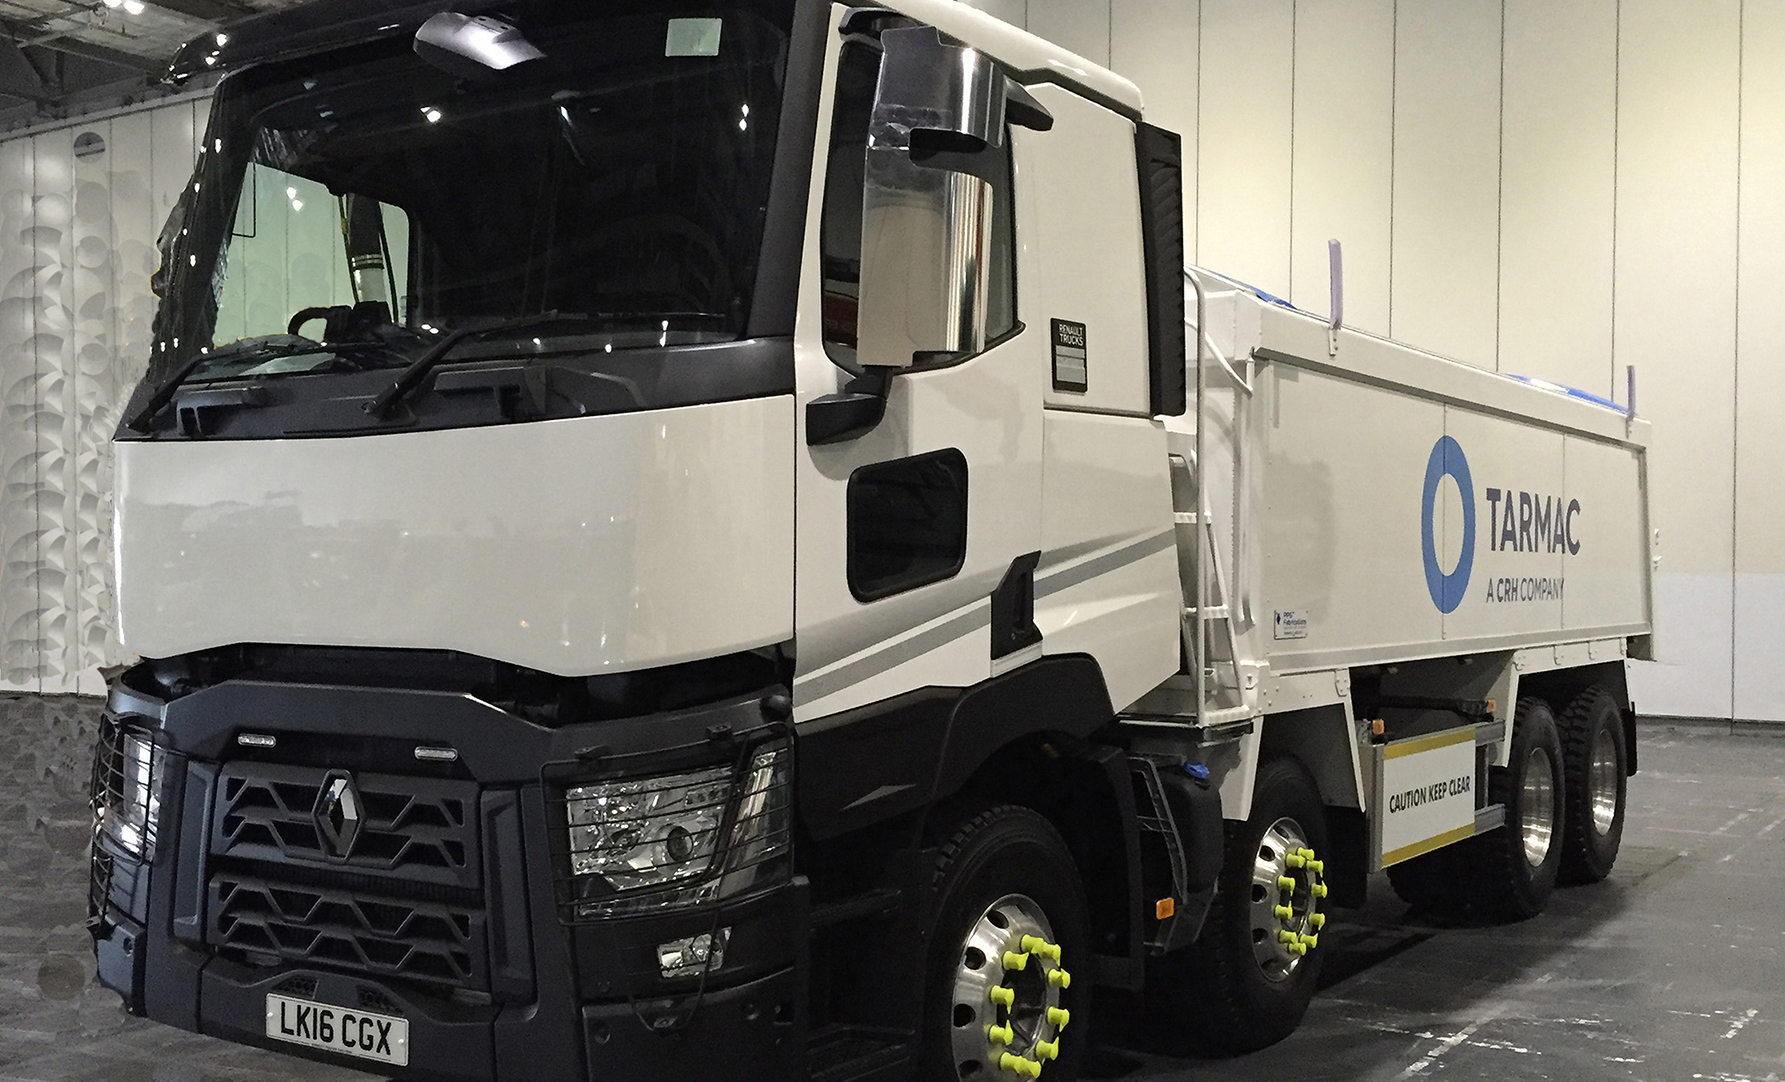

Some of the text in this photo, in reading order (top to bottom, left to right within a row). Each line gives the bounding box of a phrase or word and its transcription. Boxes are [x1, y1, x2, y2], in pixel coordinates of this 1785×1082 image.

[1059, 324, 1083, 336] RENAULT
[1060, 333, 1083, 346] TRUCKS
[1486, 487, 1581, 555] TARMAC
[1486, 577, 1565, 603] A CRH COMPANY
[1389, 775, 1471, 813] CAUTION KEEP CLEAR
[280, 1001, 392, 1056] LK16 CGX
